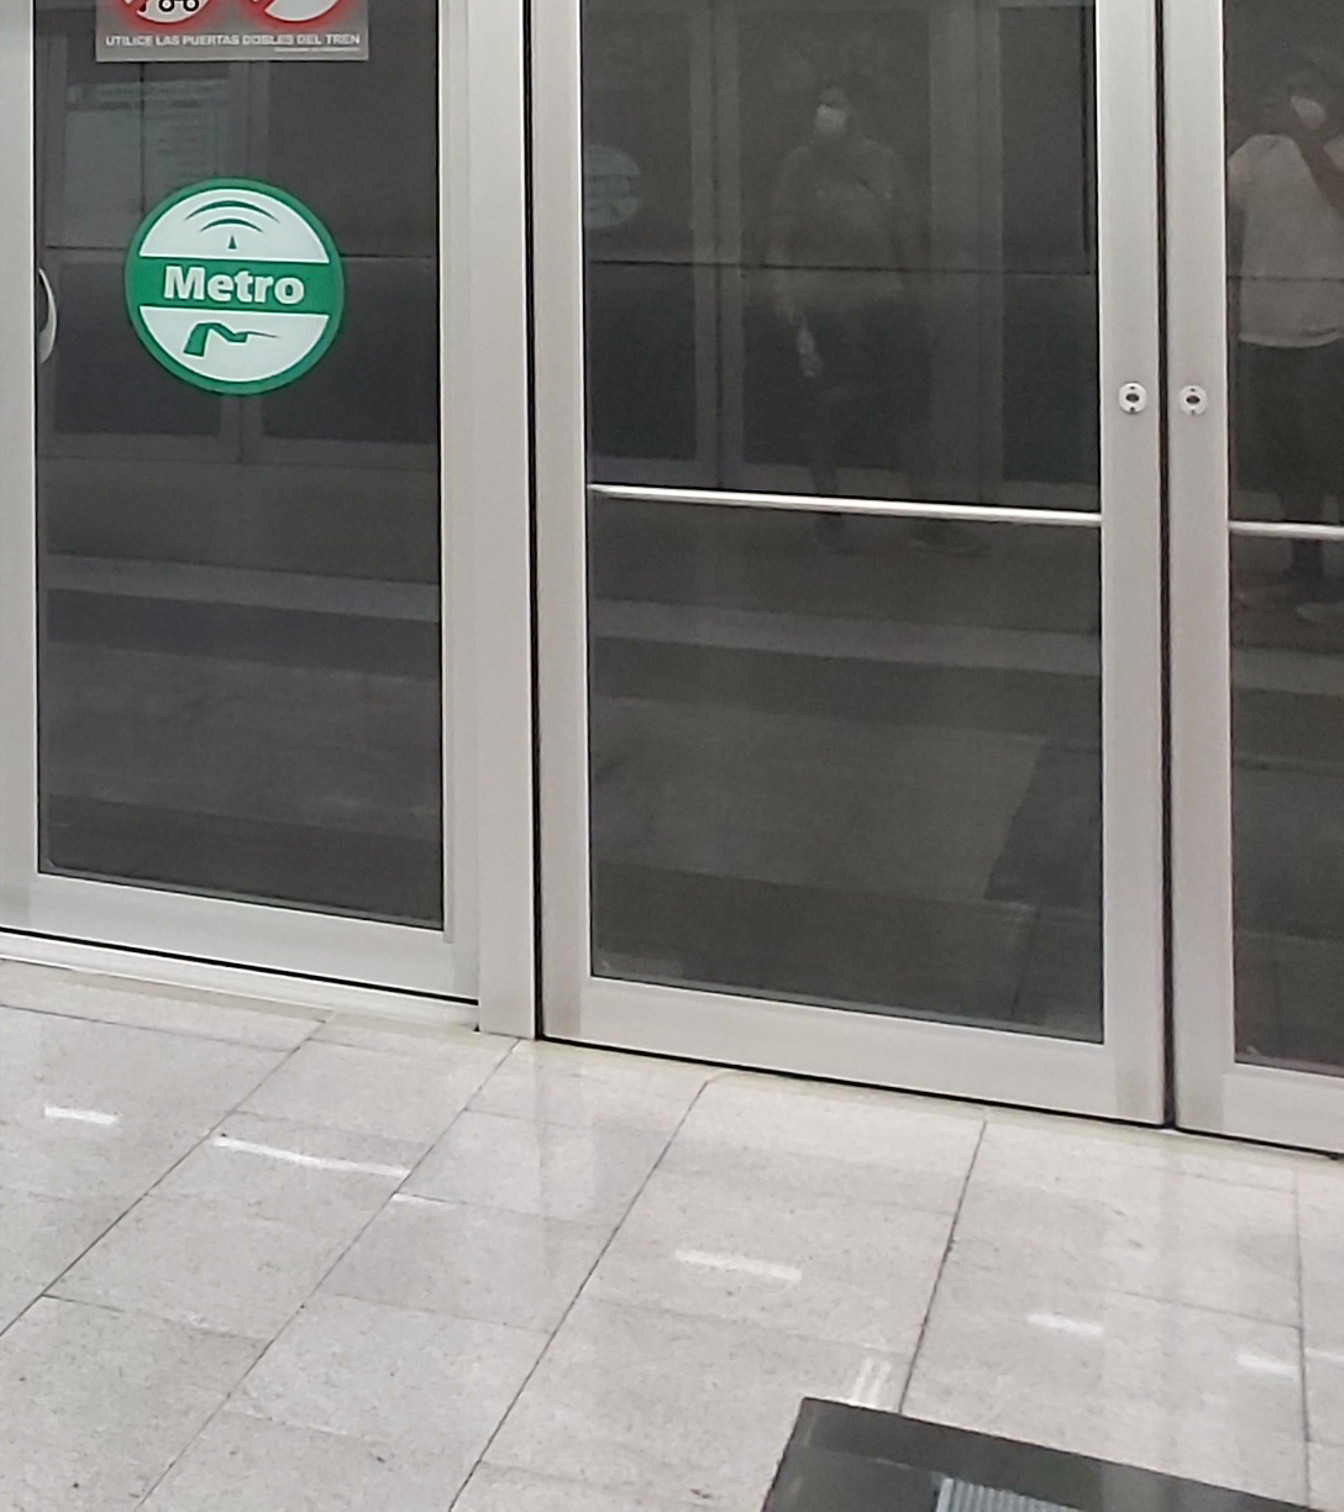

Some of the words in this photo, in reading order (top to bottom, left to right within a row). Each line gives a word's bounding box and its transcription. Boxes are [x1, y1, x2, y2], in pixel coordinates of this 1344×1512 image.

[106, 35, 152, 46] UTILICE
[155, 35, 180, 46] LAS
[182, 35, 239, 46] PUERTAS
[326, 33, 360, 45] TREN
[164, 265, 305, 304] Metro
